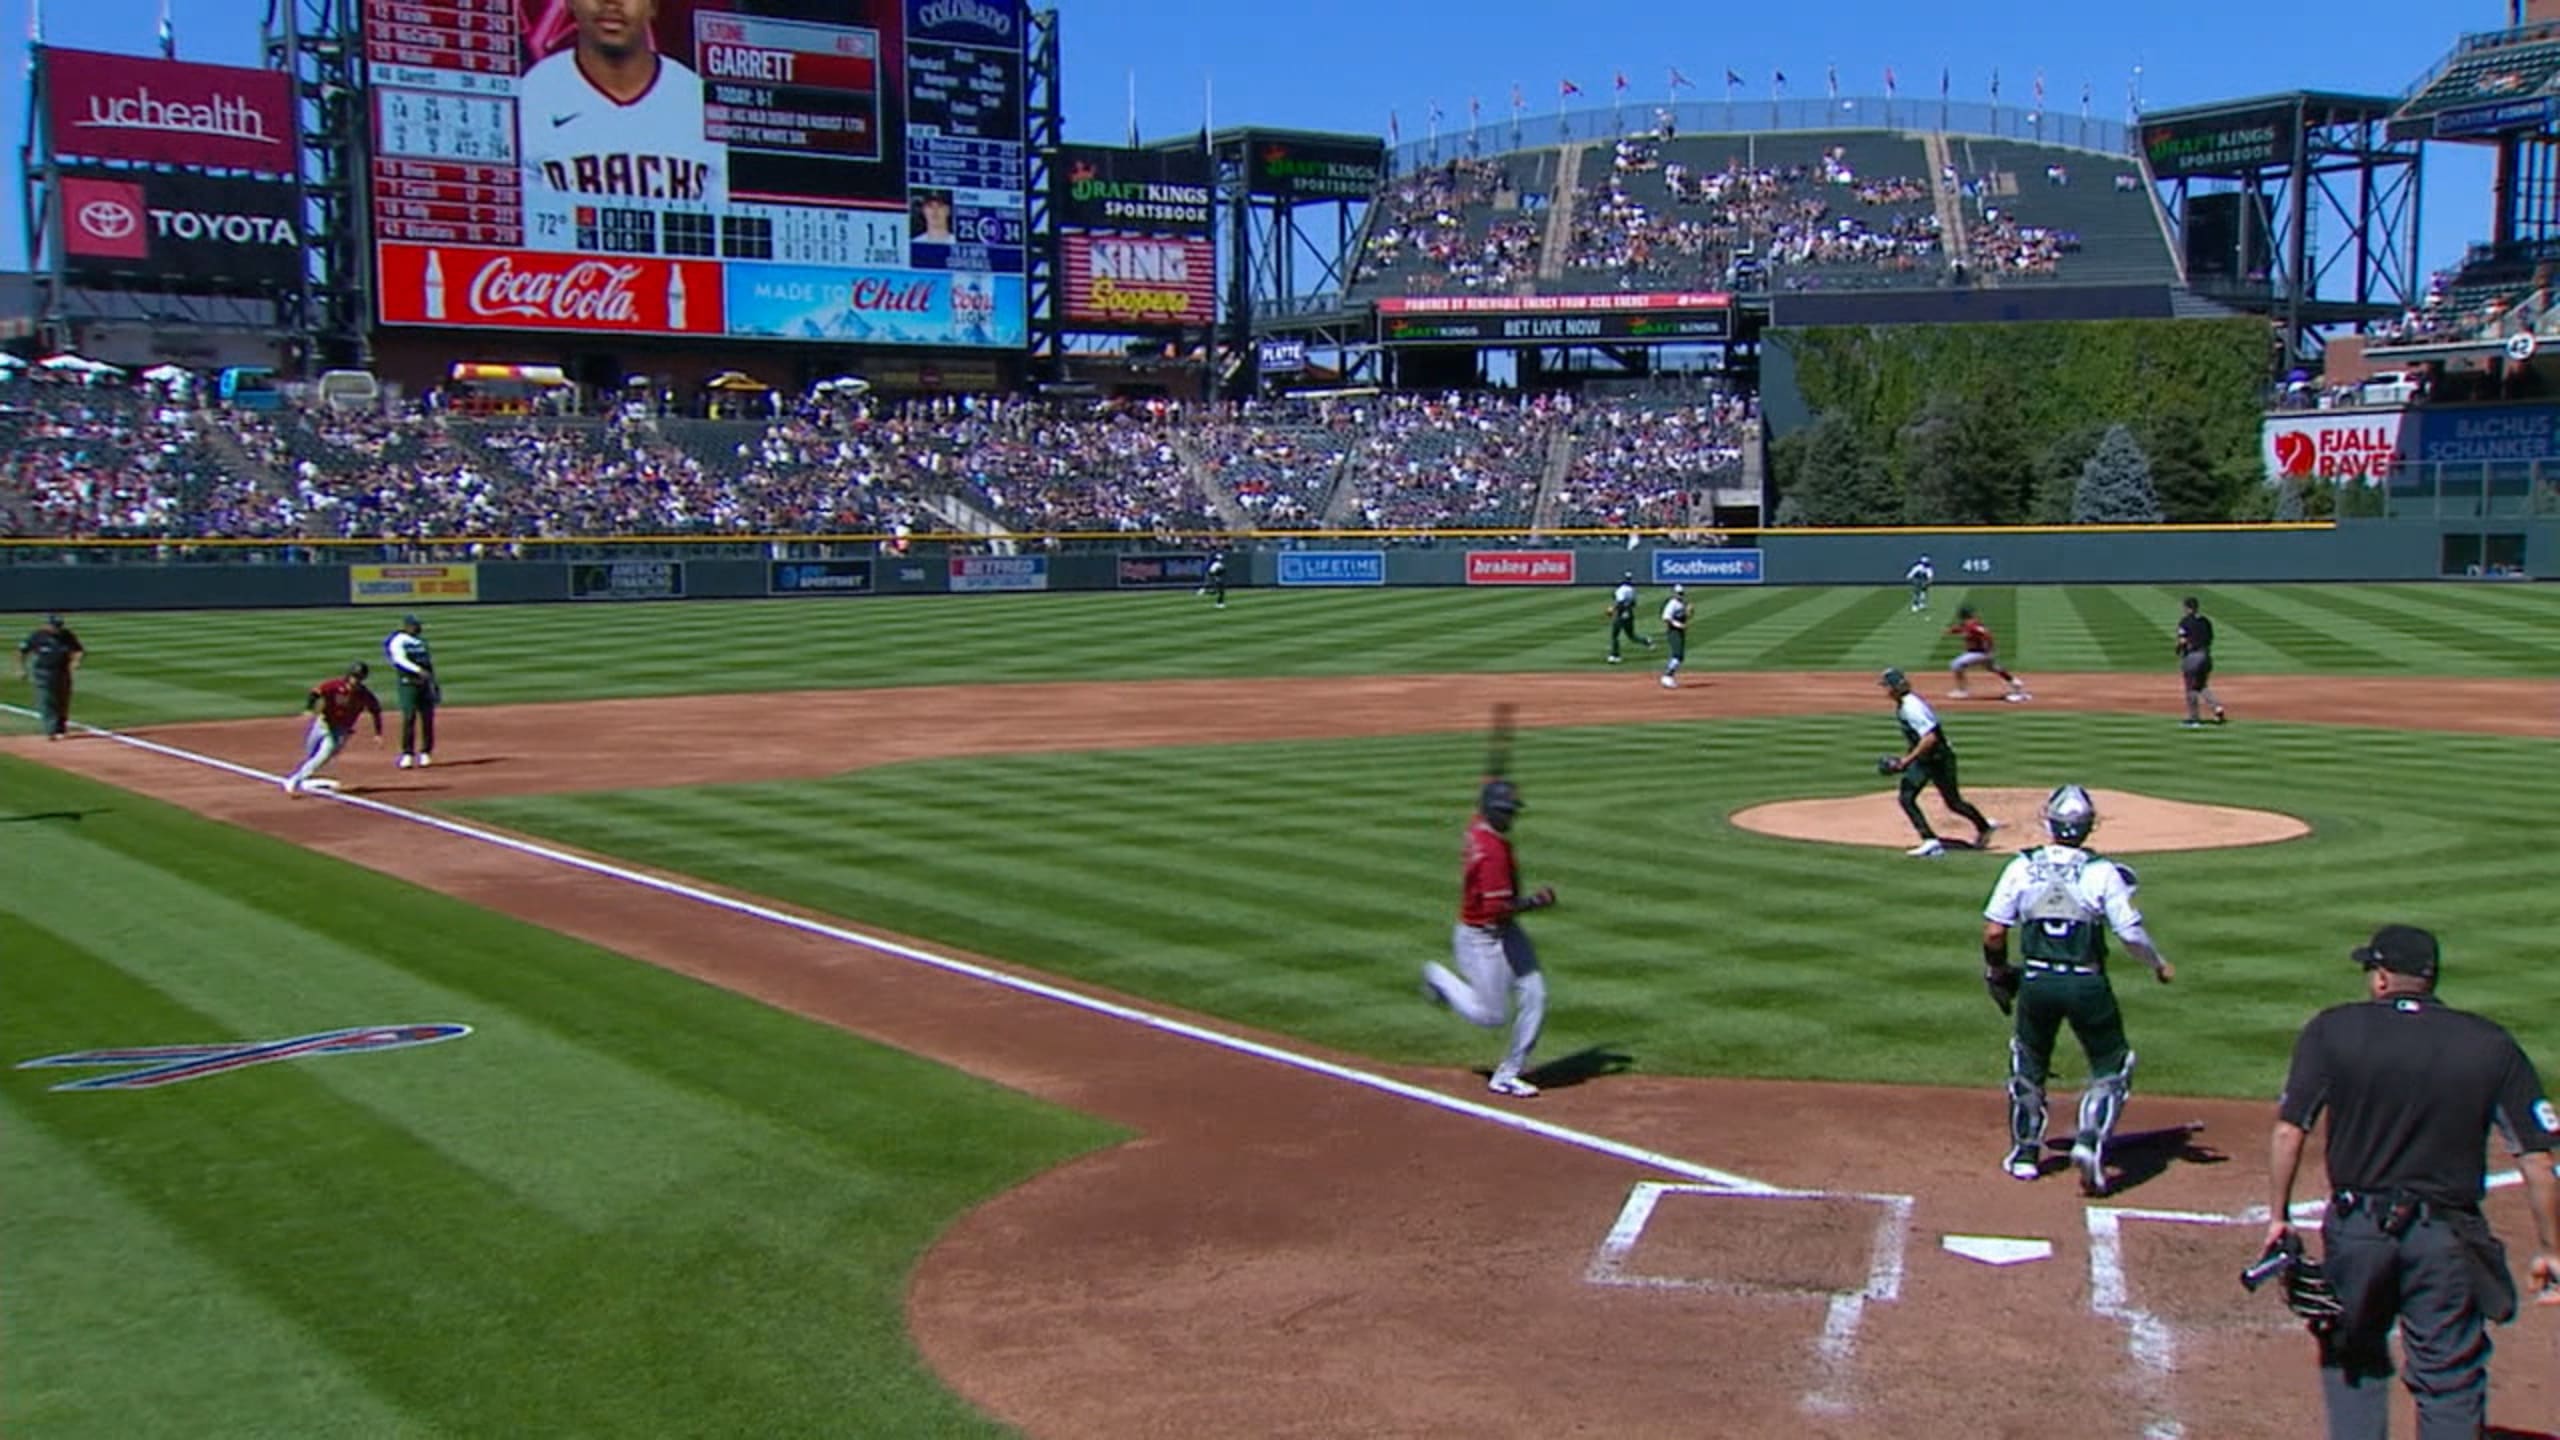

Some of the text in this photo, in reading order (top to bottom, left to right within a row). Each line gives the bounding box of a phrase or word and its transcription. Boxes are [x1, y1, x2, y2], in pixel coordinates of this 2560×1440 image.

[708, 45, 794, 81] GARRETT
[90, 86, 263, 136] uchealth
[2150, 126, 2275, 161] DRAFTKINGS
[2178, 144, 2273, 168] SPORTSBOOK
[1072, 179, 1208, 205] DRAFTKINGS
[1104, 201, 1208, 221] SPORTSBOOK
[150, 209, 297, 246] TOYOTA
[1090, 242, 1187, 282] KING
[470, 256, 643, 322] Coca-Cola
[755, 276, 937, 313] MADE TO Chill
[1503, 318, 1600, 336] BET LIVE NOW
[2427, 437, 2547, 460] SCHANKER
[964, 560, 1035, 575] BETFRED
[1474, 558, 1567, 577] brakes plus
[1661, 559, 1743, 575] Southwest
[1962, 559, 1990, 572] 415
